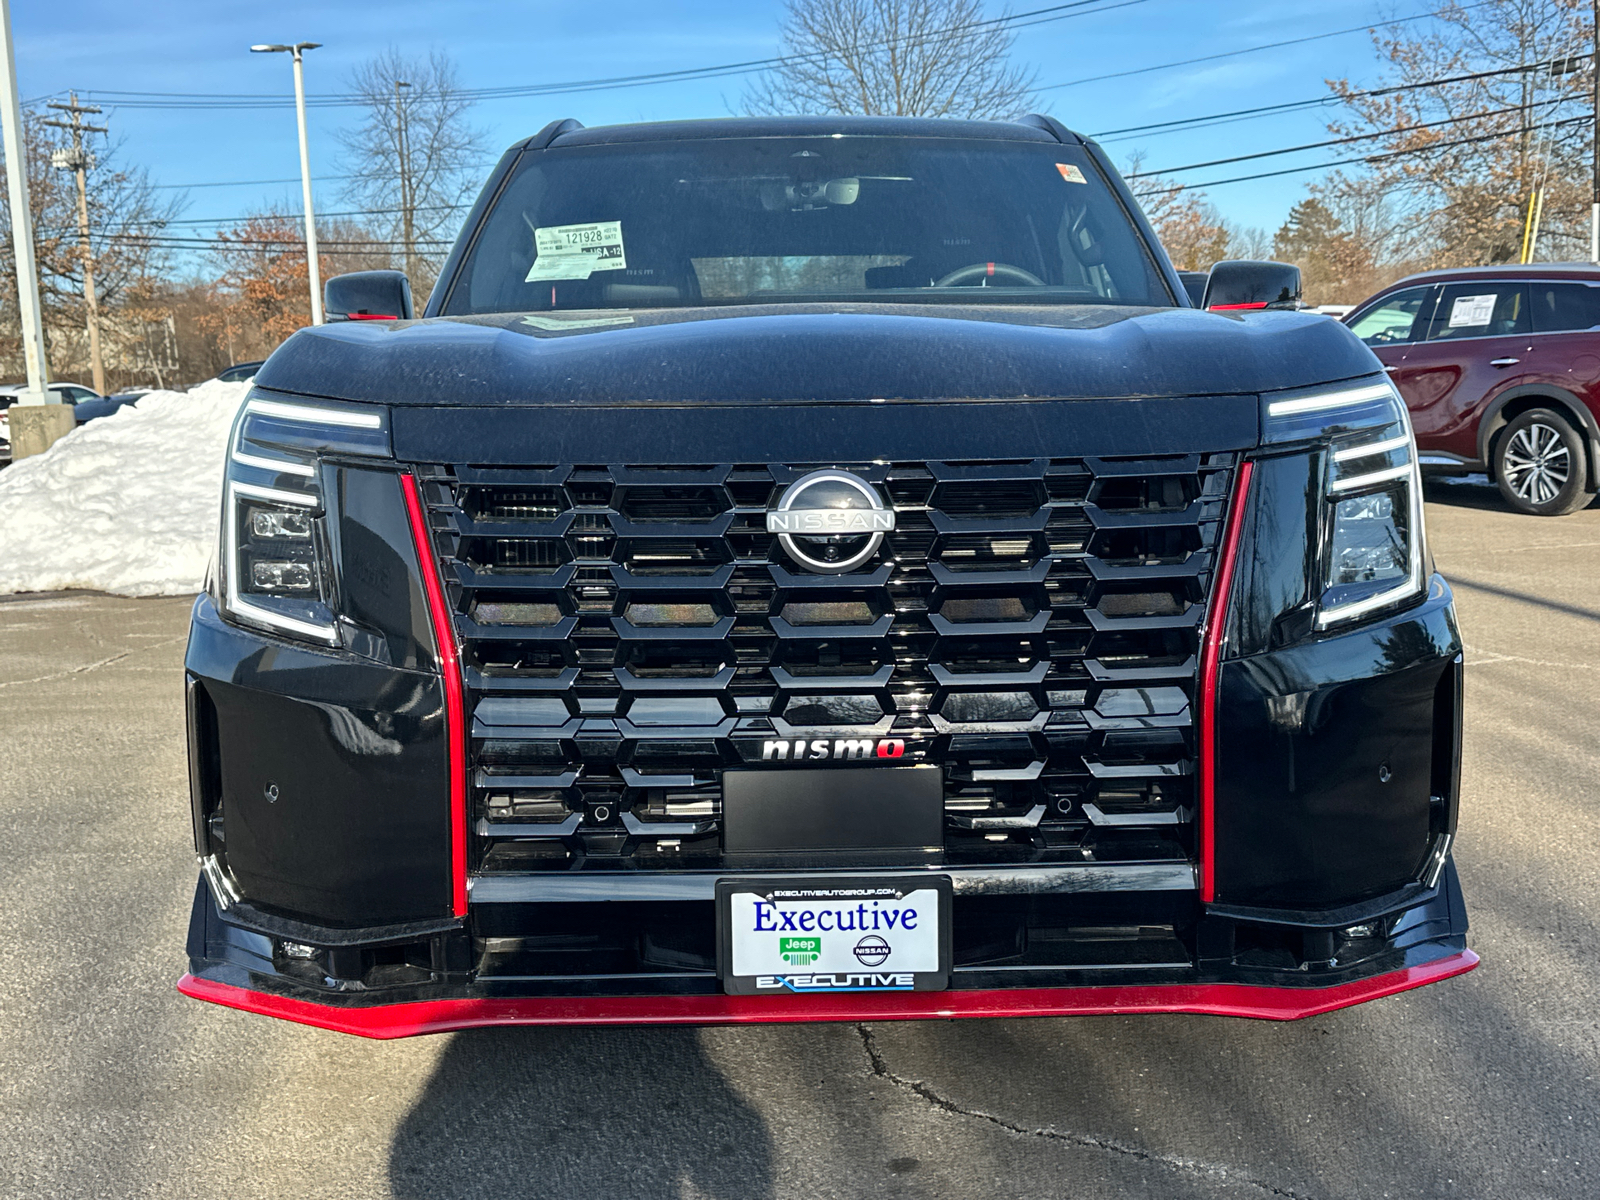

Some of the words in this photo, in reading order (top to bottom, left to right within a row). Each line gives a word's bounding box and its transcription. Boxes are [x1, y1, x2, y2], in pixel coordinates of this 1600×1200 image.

[566, 231, 603, 245] 121928
[770, 513, 892, 530] NISSAN
[762, 739, 905, 760] nismo
[774, 888, 896, 897] EXECUTIVEAUTOGROUP.COM
[753, 901, 918, 932] Executive
[785, 938, 816, 951] Jeep
[756, 973, 914, 989] EXECUTIVE
